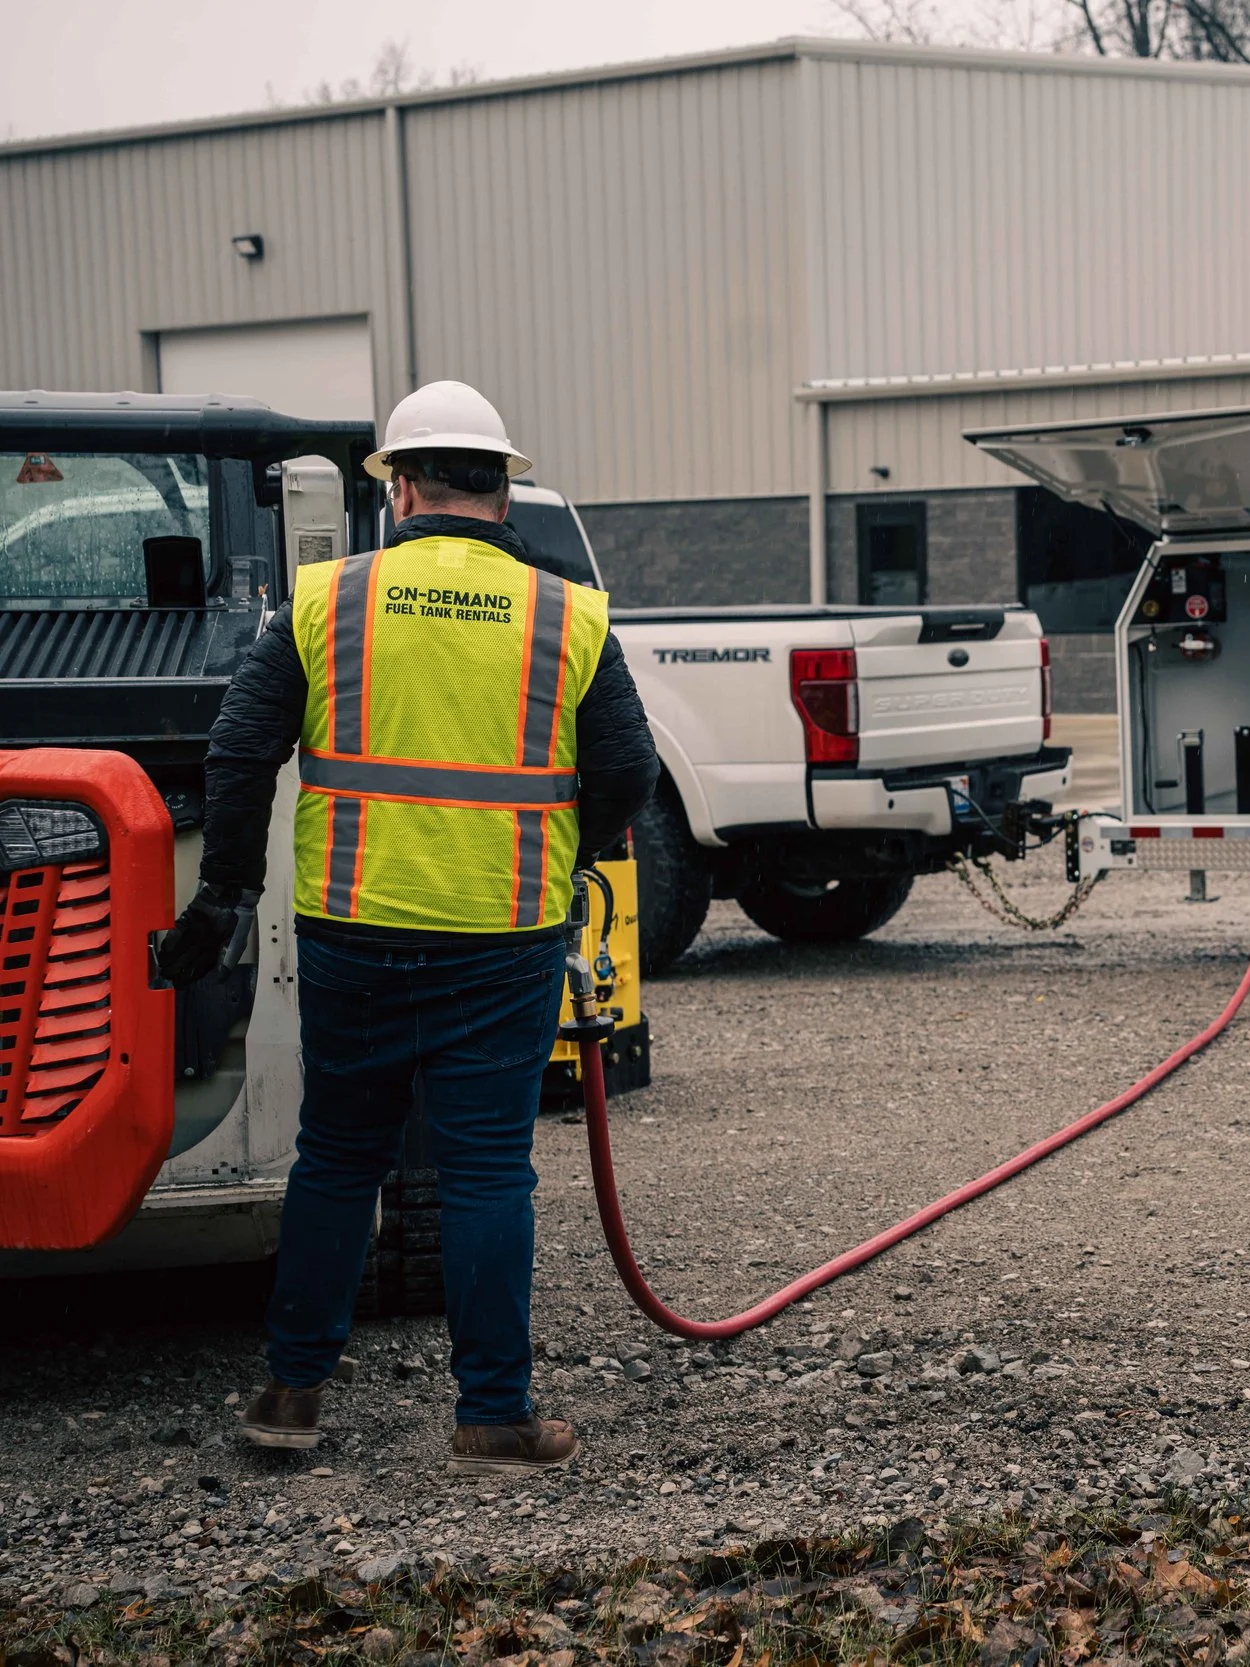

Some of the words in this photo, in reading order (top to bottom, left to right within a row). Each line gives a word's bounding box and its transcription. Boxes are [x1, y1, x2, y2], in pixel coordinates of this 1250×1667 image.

[386, 586, 513, 610] ON-DEMAND
[385, 603, 416, 616] FUEL
[419, 605, 453, 619] TANK
[455, 609, 513, 624] RENTALS
[652, 647, 773, 664] TREMOR
